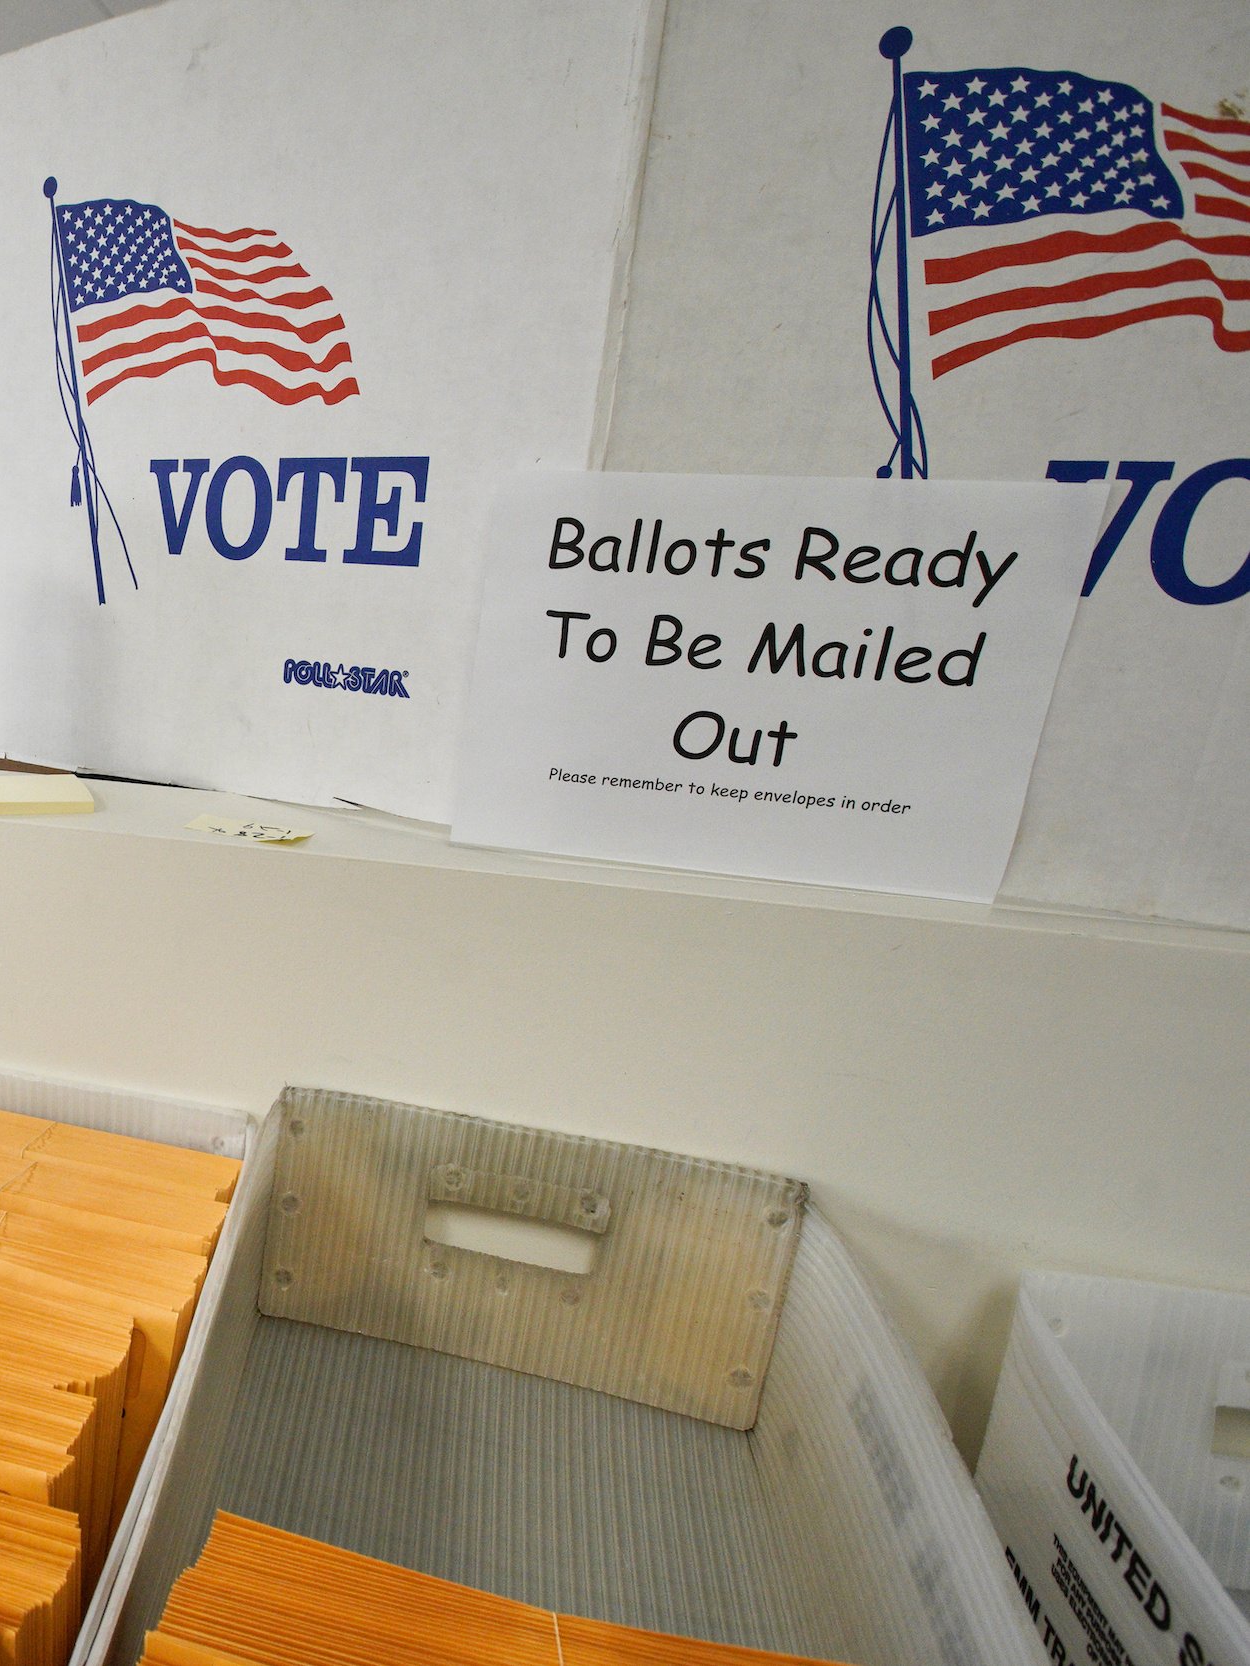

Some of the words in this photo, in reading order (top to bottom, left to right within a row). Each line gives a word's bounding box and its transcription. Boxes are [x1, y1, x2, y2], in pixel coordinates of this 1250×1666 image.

[149, 455, 430, 568] VOTE
[548, 516, 771, 580] Ballots
[794, 526, 1019, 609] Ready
[545, 609, 618, 663] To
[643, 614, 723, 670] Be
[747, 621, 987, 687] Mailed
[672, 710, 799, 768] Out
[548, 767, 597, 785] Please
[601, 776, 683, 793] remember
[688, 781, 705, 795] to
[710, 782, 749, 803] keep
[753, 789, 836, 810] envelopes
[840, 795, 856, 810] in
[860, 799, 912, 815] order
[1056, 1556, 1071, 1586] FOR
[1066, 1454, 1171, 1632] UNITED
